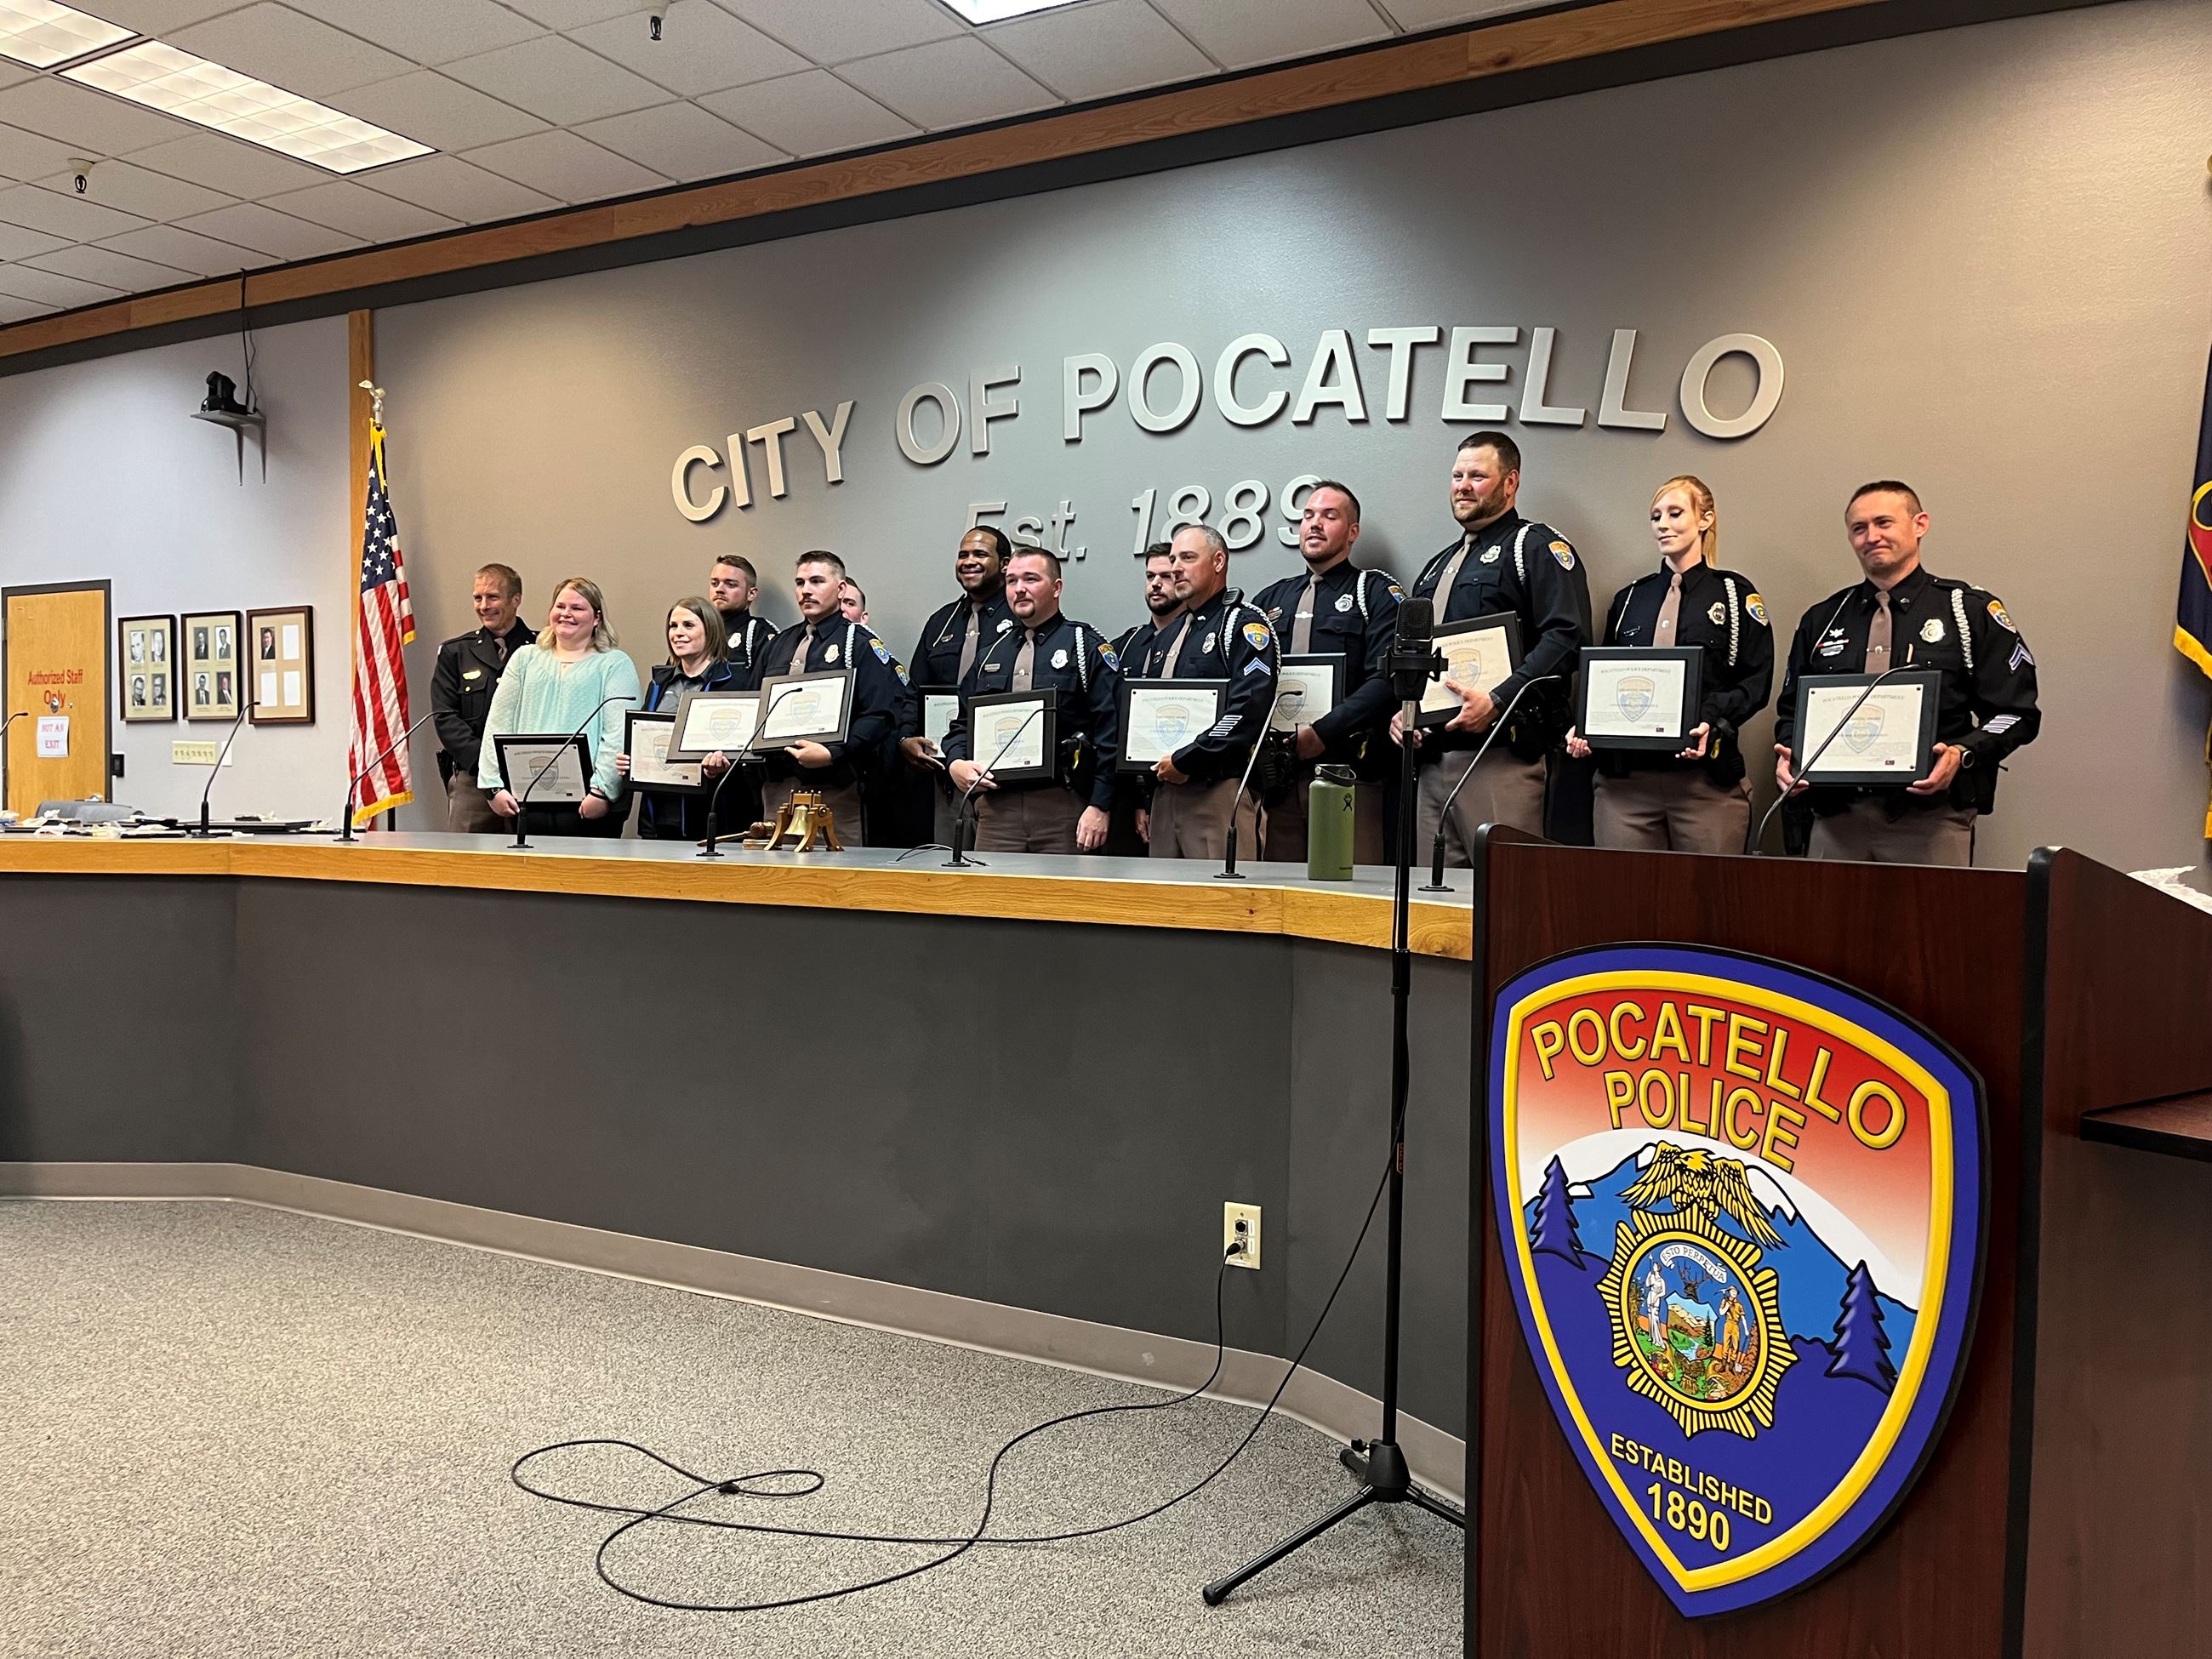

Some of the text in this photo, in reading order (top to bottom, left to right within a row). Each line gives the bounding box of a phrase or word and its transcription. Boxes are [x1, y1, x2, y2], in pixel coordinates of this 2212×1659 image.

[671, 325, 1786, 522] CITY OF POCATELLO
[27, 669, 83, 685] Authorized Staff
[43, 689, 66, 709] Only
[1531, 1001, 1907, 1150] POCATELLO
[1604, 1068, 1807, 1172] POLICE
[1661, 1246, 1725, 1282] ESTO PERPETUA
[1611, 1432, 1774, 1525] ESTABLISHED
[1647, 1482, 1730, 1552] 1890
